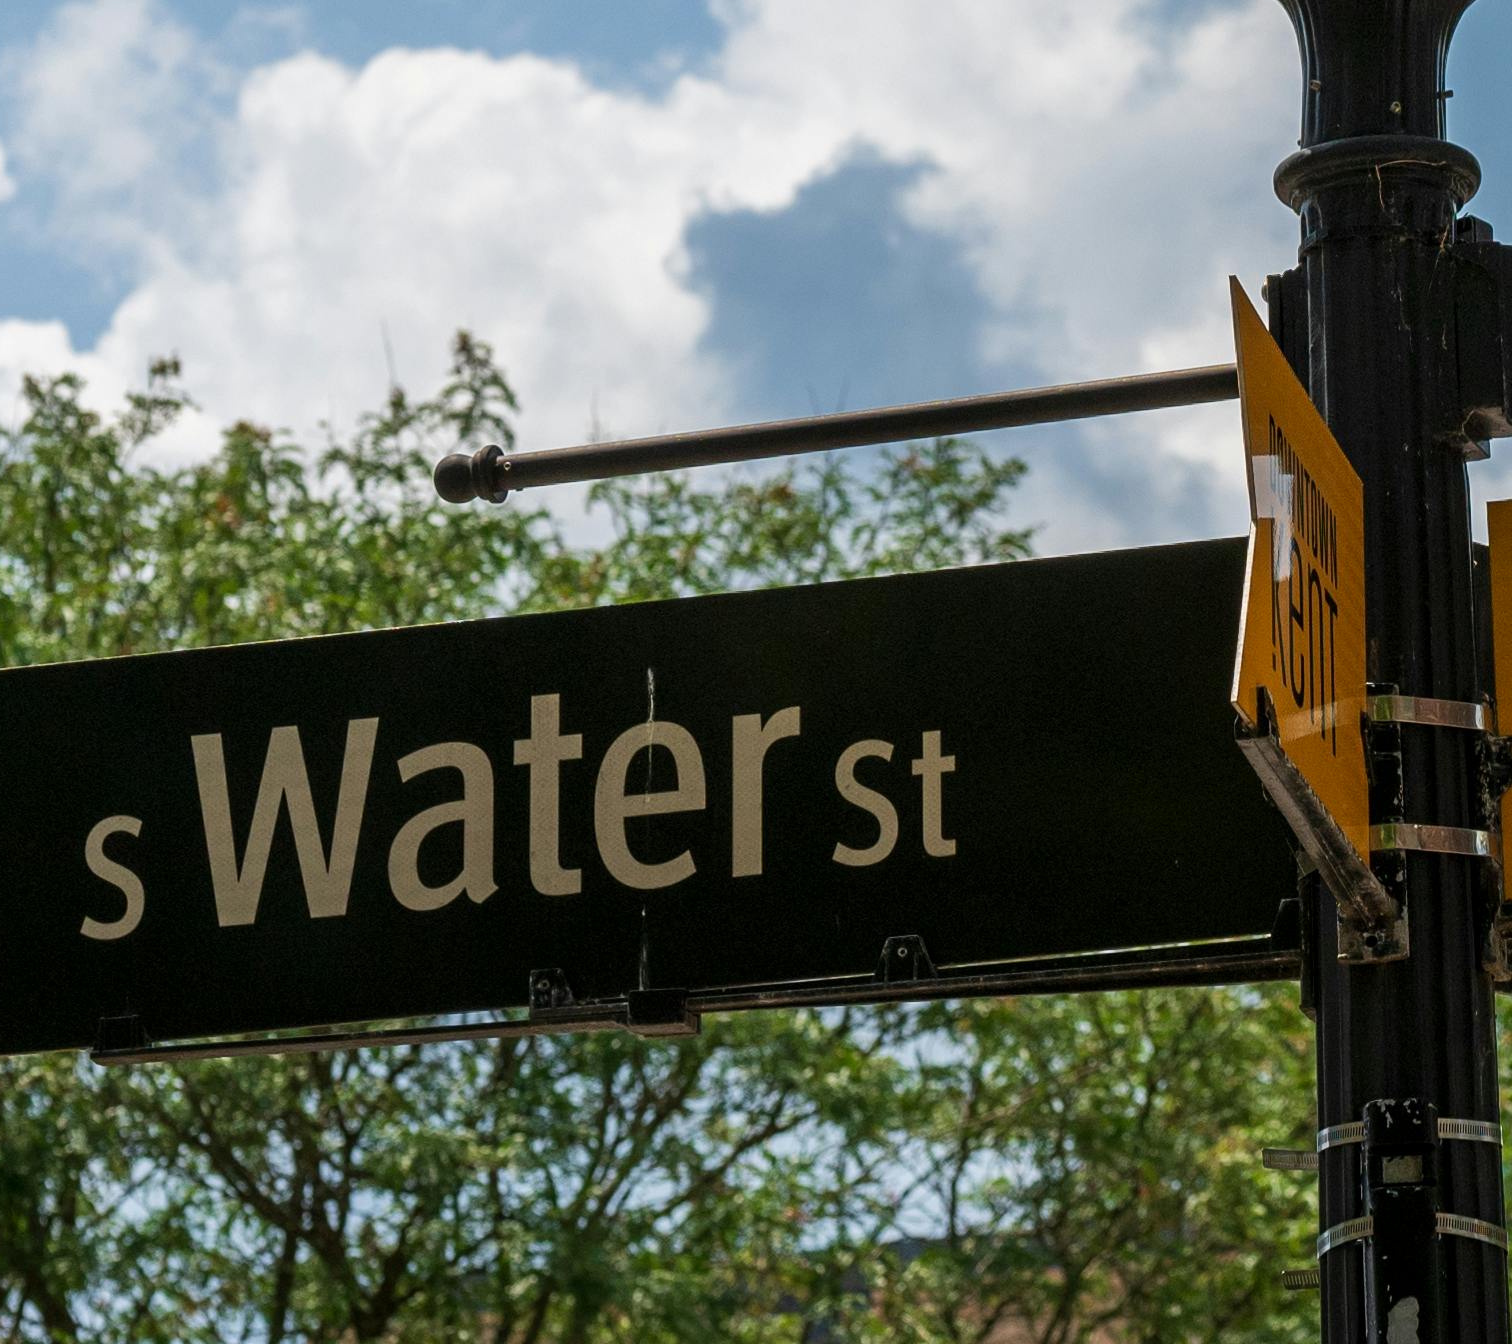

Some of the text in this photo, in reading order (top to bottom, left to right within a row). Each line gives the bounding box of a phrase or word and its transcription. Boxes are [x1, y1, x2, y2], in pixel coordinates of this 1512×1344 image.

[78, 692, 957, 942] S Water St
